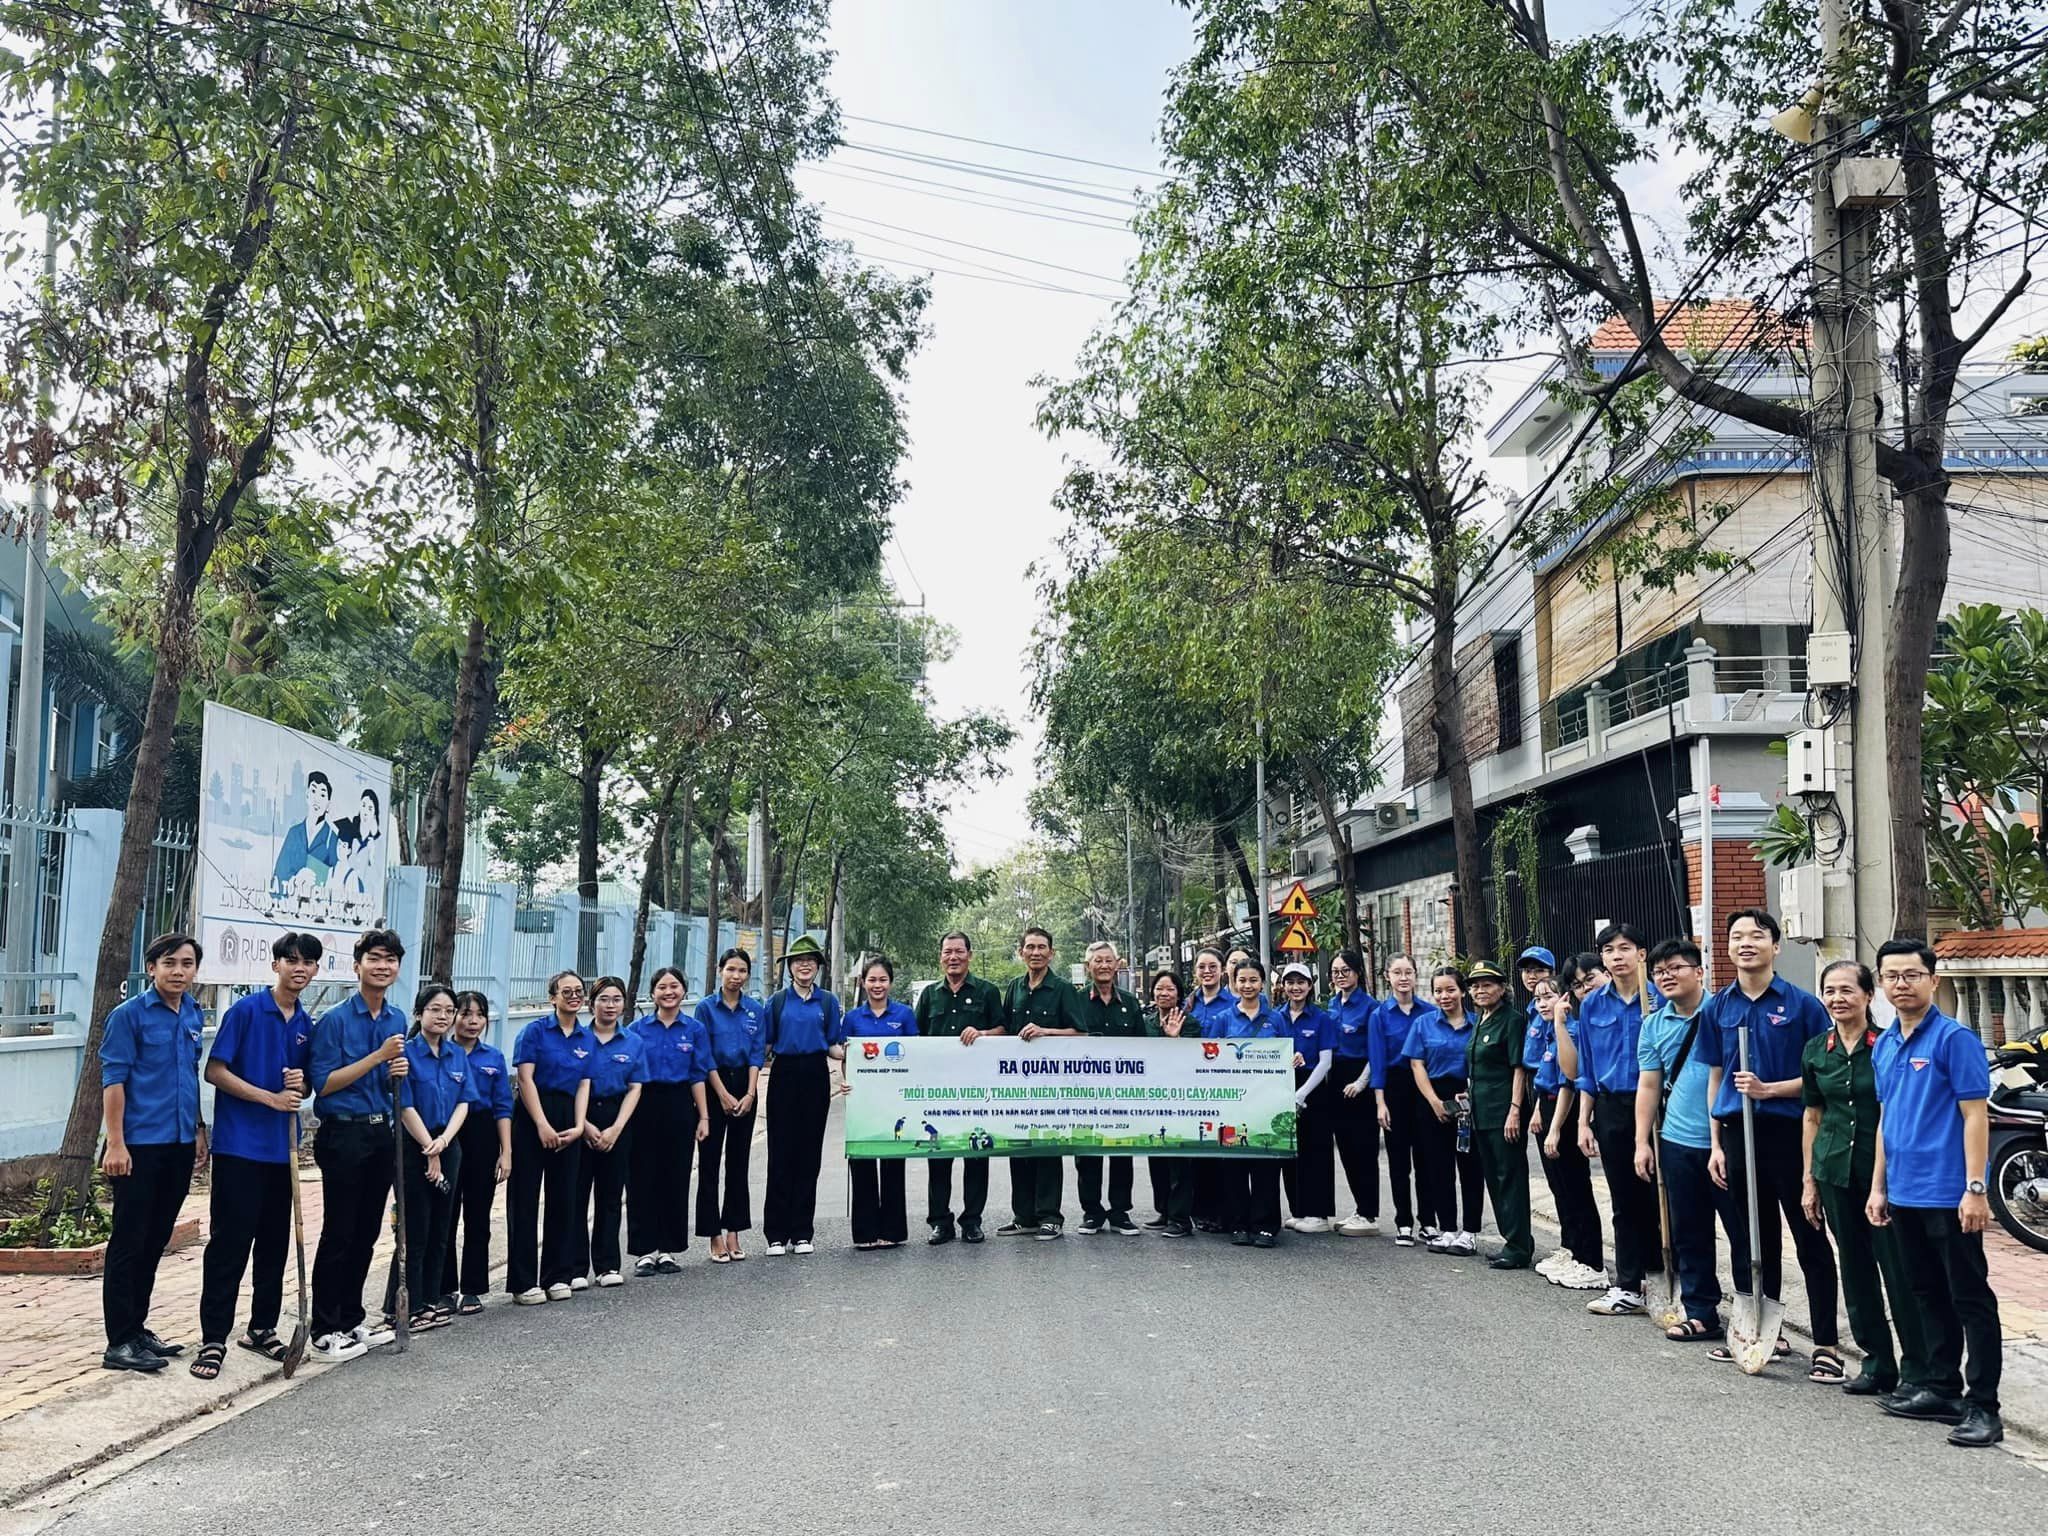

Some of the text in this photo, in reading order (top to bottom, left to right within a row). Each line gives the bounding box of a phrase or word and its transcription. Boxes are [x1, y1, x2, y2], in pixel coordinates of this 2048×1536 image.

[999, 1056, 1145, 1077] RA QUÂN HƯỞNG ỨNG
[991, 1087, 1027, 1099] THANH
[1170, 1087, 1182, 1099] 01
